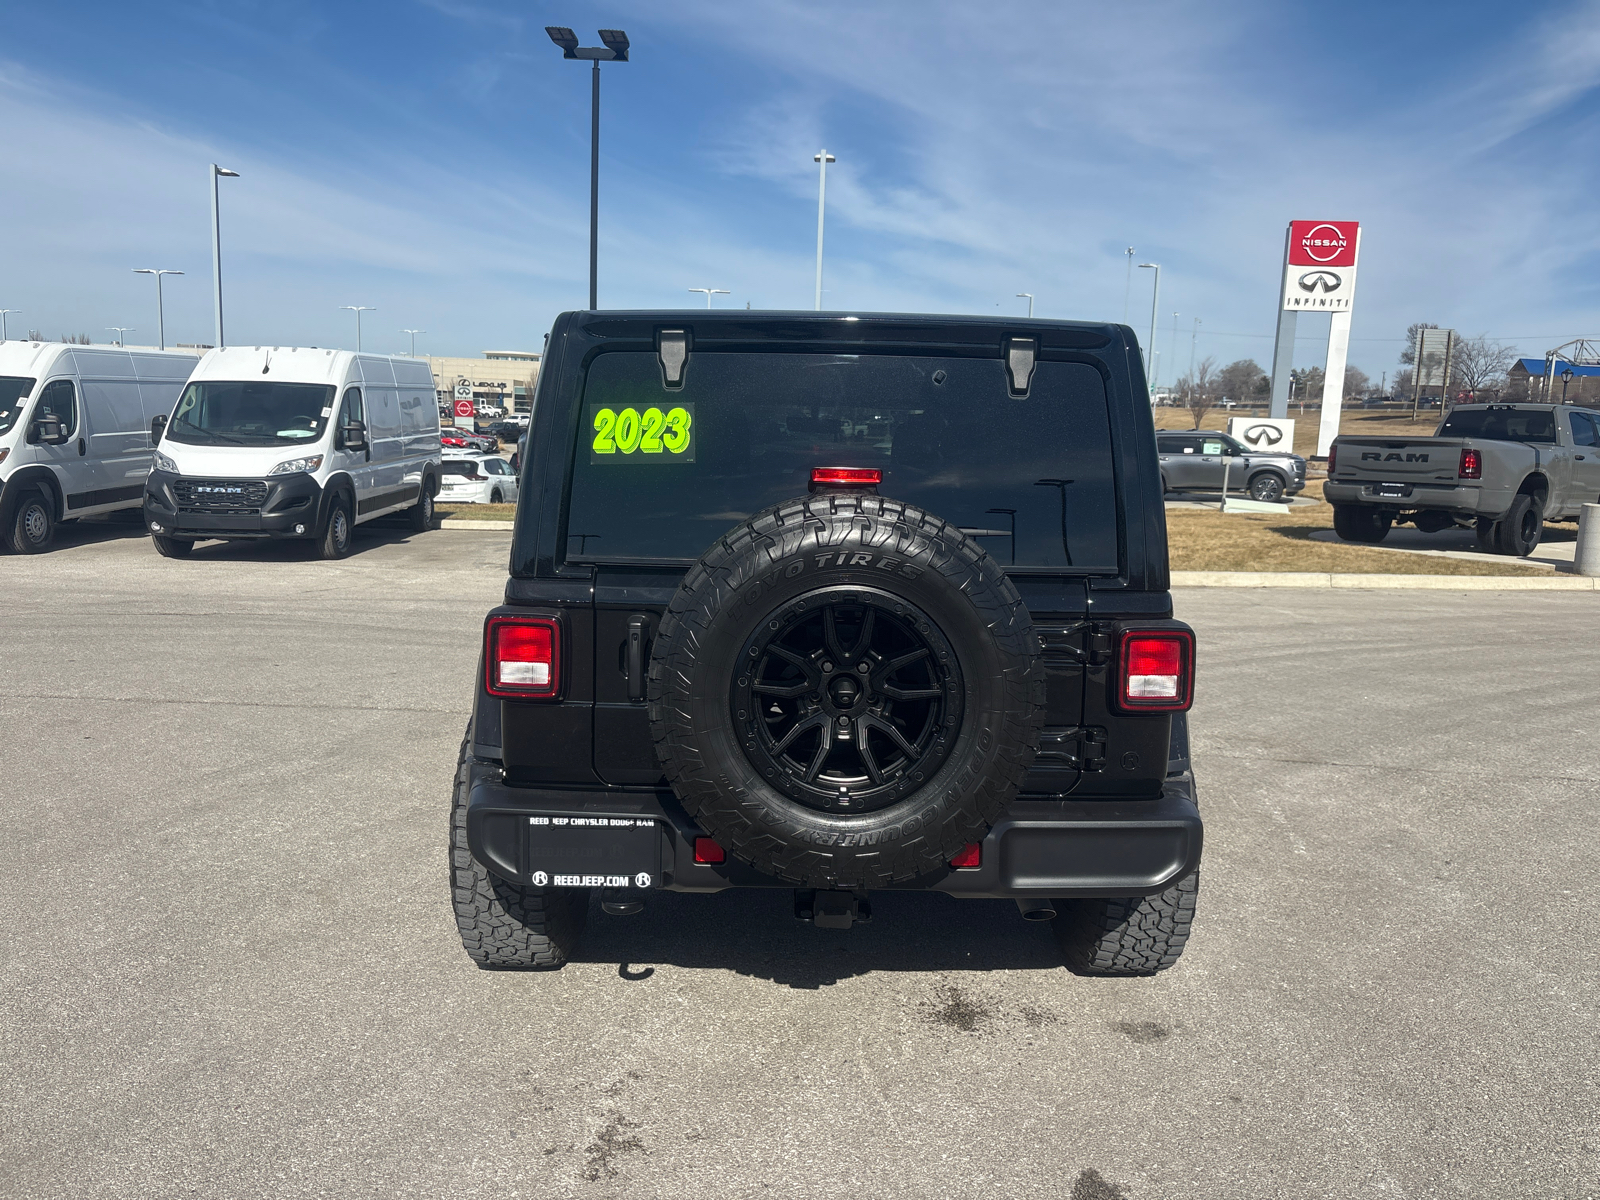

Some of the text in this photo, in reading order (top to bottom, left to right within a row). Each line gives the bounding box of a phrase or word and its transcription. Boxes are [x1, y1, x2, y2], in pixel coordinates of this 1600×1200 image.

[1302, 239, 1347, 247] NISSAN
[1287, 298, 1349, 307] INFINITI
[592, 407, 692, 454] 2023
[1361, 452, 1430, 463] RAM
[727, 558, 804, 621] TOYO
[814, 550, 925, 580] TIRES
[529, 817, 549, 825] REED
[570, 818, 608, 826] CHRYSLER
[636, 819, 655, 827] RAM
[554, 875, 629, 887] REEDJEEP.COM
